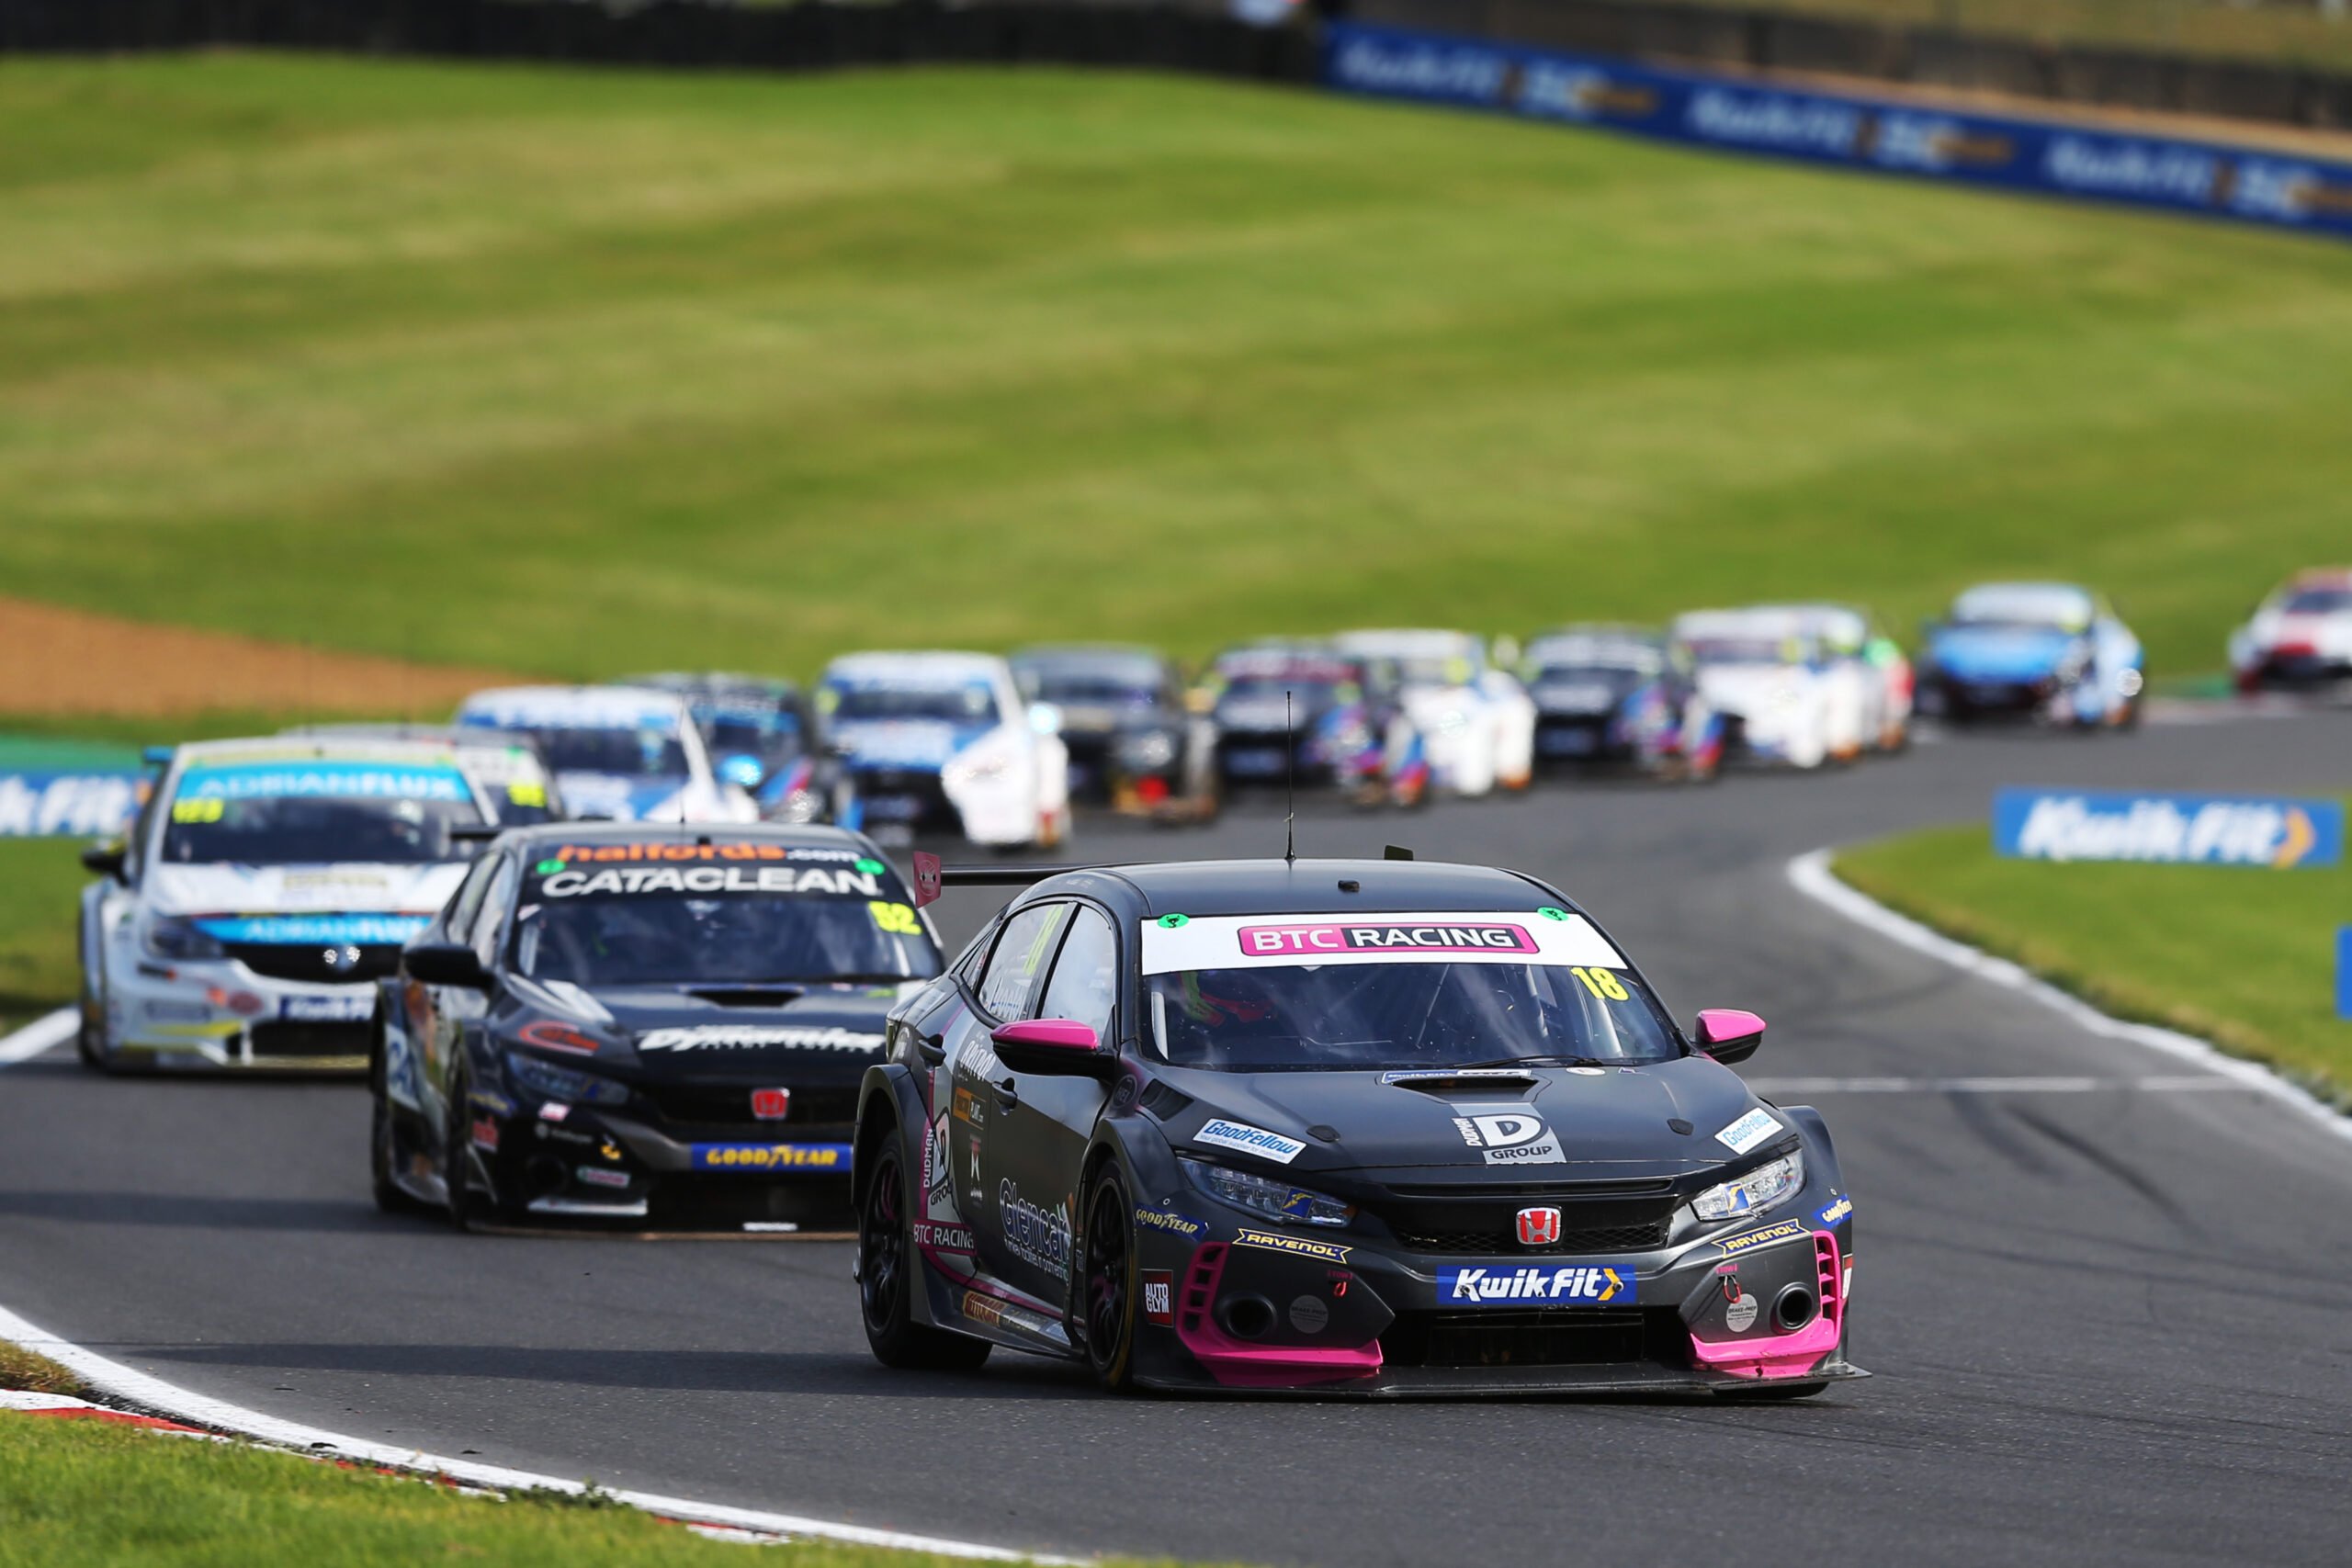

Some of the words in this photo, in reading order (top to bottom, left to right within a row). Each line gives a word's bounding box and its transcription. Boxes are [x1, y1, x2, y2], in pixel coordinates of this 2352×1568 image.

[542, 866, 879, 897] CATACLEAN
[1250, 928, 1339, 950] BTC
[1351, 927, 1516, 948] RACING
[1570, 966, 1630, 1001] 18
[1491, 1145, 1553, 1159] GROUP
[1246, 1234, 1338, 1258] RAVENOL
[1724, 1224, 1798, 1251] RAVENOL
[1145, 1282, 1169, 1299] AUTO
[1146, 1297, 1170, 1314] GLYM
